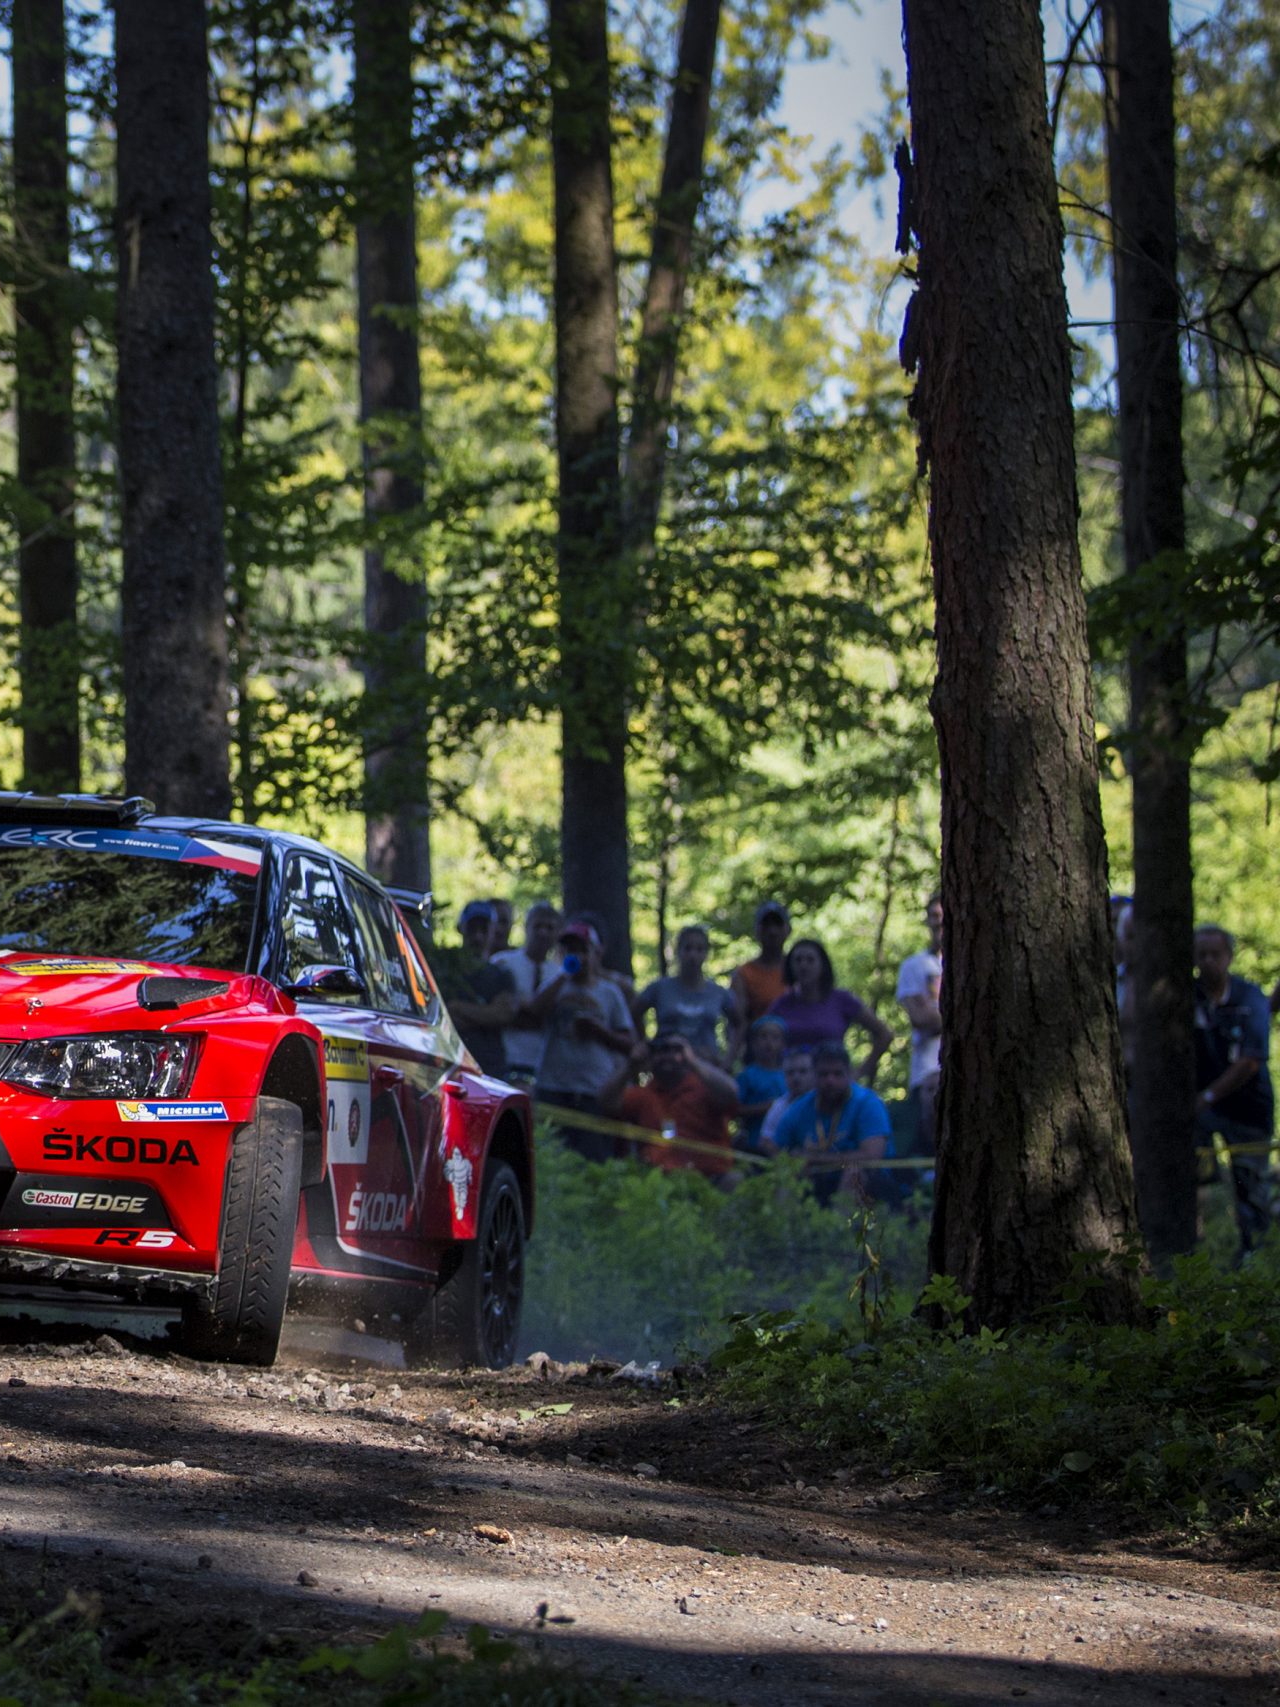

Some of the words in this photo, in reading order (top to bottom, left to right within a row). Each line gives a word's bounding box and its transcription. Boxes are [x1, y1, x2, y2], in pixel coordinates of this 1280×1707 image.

[157, 1106, 223, 1116] MICHELIN
[43, 1127, 200, 1166] ŠKODA
[35, 1191, 73, 1206] Castrol
[75, 1192, 149, 1213] EDGE
[345, 1182, 407, 1231] ŠKODA
[94, 1229, 178, 1248] R5
